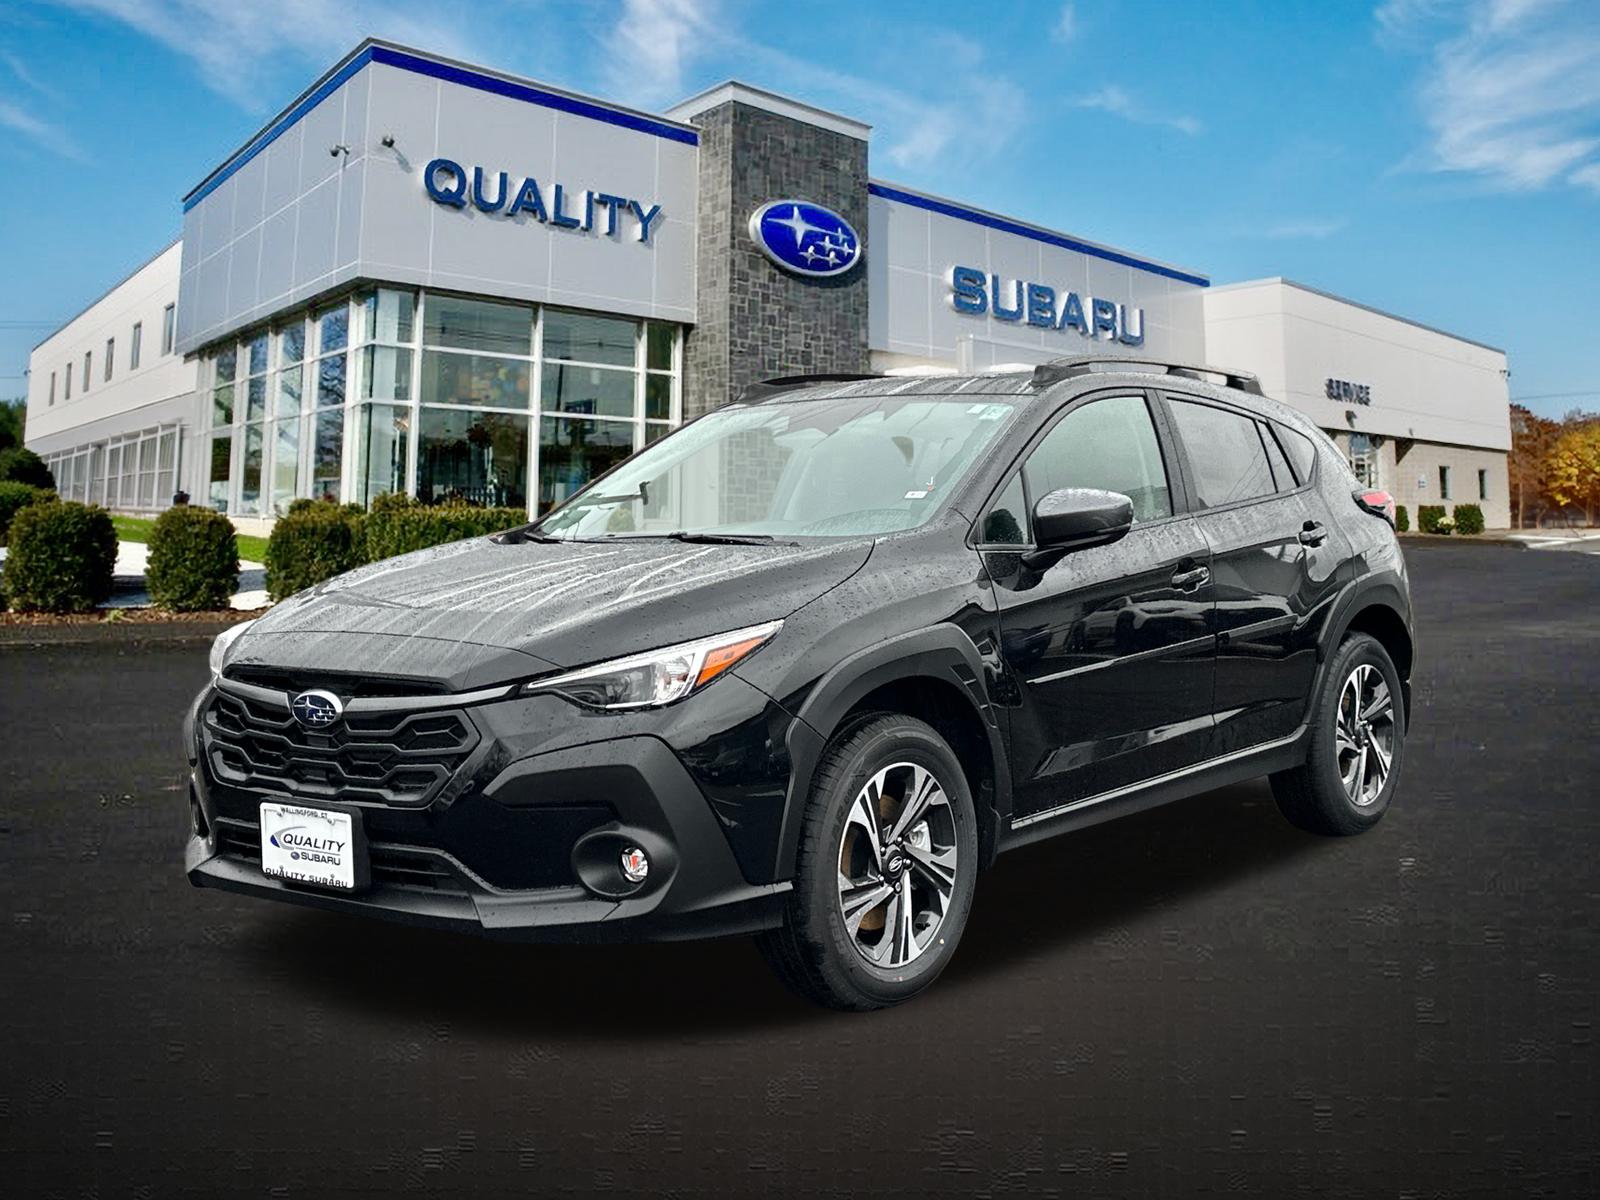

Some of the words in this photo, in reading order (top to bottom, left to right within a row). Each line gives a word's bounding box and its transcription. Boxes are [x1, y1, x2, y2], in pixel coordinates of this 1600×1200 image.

[424, 158, 662, 243] QUALITY
[951, 265, 1145, 347] SUBARU
[283, 833, 346, 852] QUALITY
[300, 852, 341, 866] SUBARU
[265, 867, 306, 880] QUALITY
[308, 874, 348, 888] SUBARU
